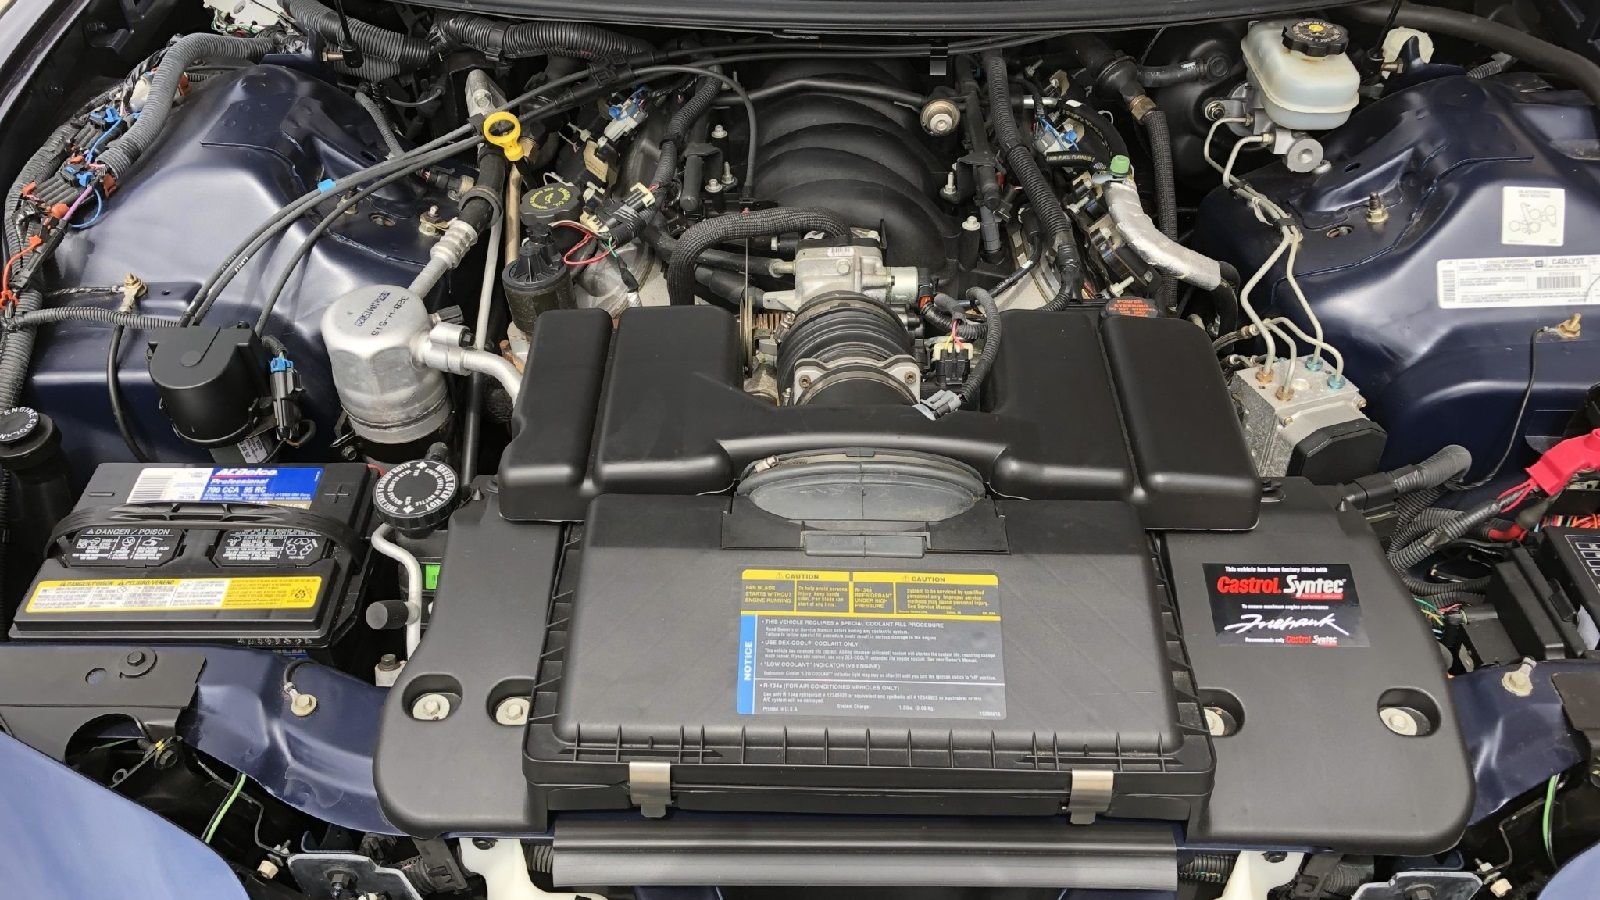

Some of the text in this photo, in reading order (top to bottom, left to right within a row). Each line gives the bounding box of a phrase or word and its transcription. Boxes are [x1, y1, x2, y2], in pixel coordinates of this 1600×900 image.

[1217, 575, 1344, 598] Castrol Syntec
[1286, 636, 1312, 644] Castrol
[1313, 635, 1337, 645] Syntec
[744, 641, 752, 680] NOTICE
